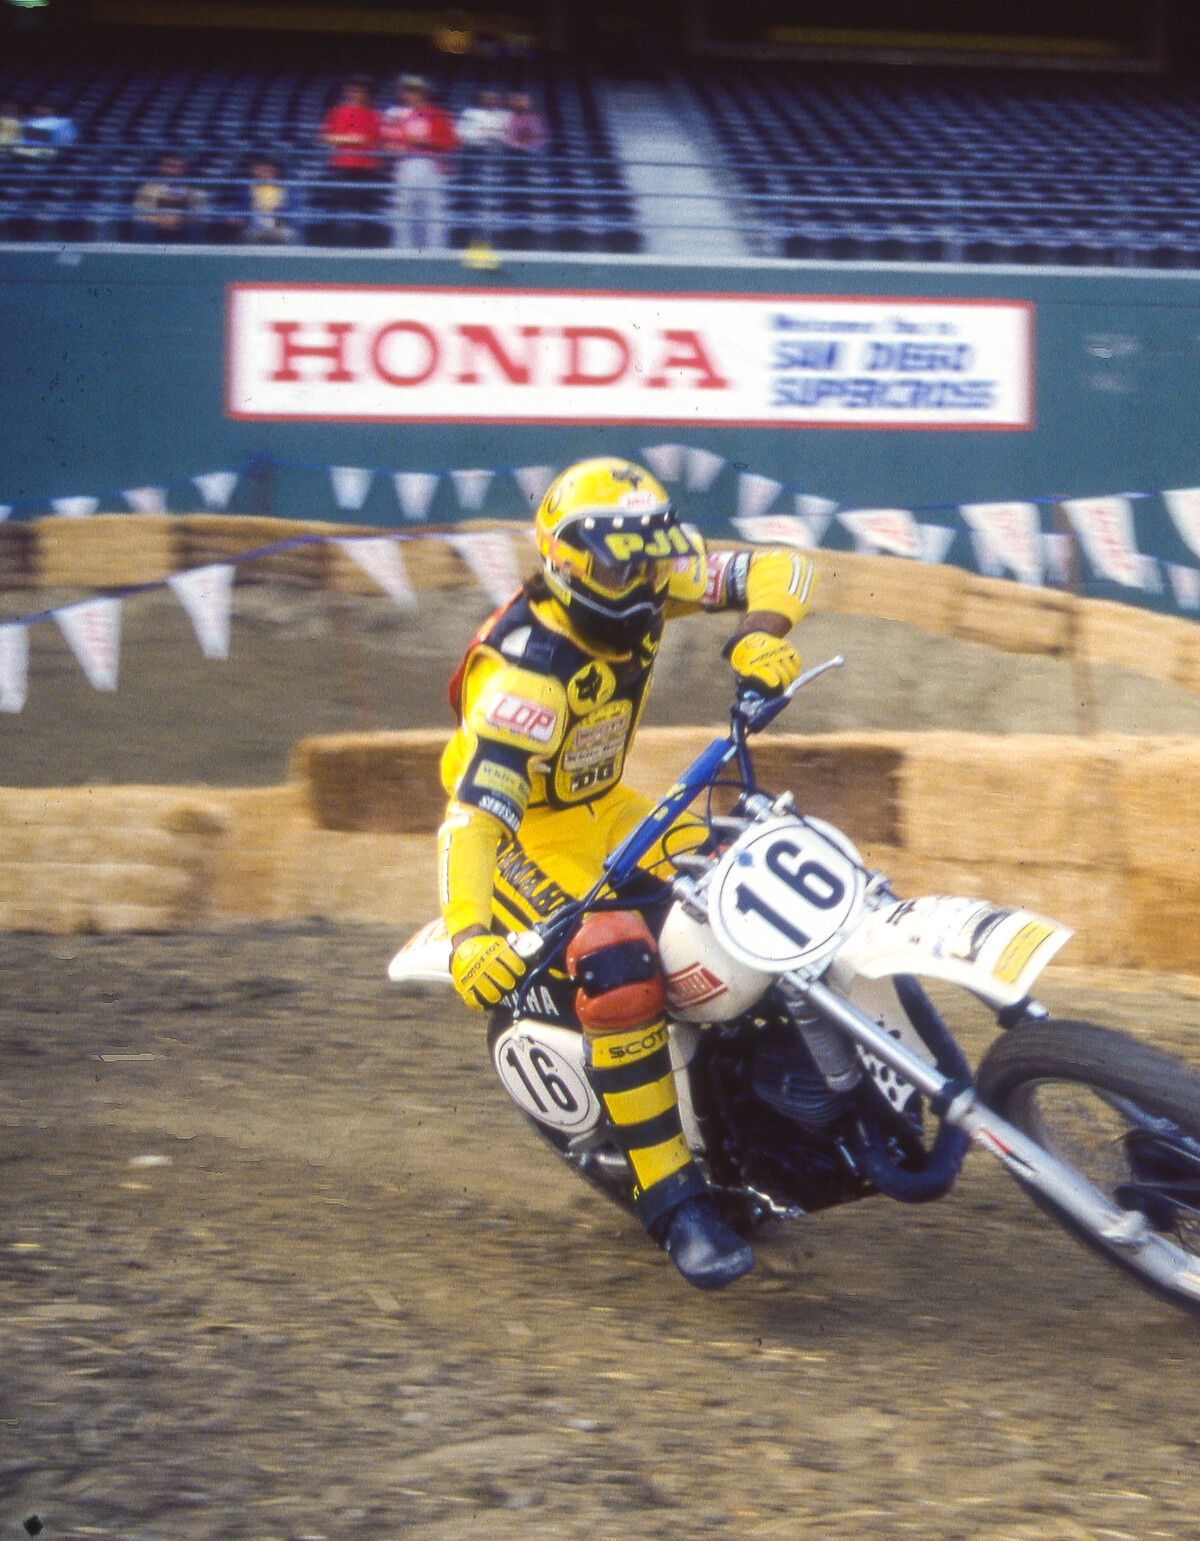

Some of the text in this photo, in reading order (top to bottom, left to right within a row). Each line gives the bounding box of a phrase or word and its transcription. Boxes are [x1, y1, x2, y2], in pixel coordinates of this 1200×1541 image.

[266, 320, 732, 389] HONDA
[769, 340, 840, 371] SAN
[769, 377, 996, 409] SUPERCROSS
[604, 525, 690, 561] PJ1
[735, 839, 846, 949] 16
[506, 1045, 579, 1114] 16
